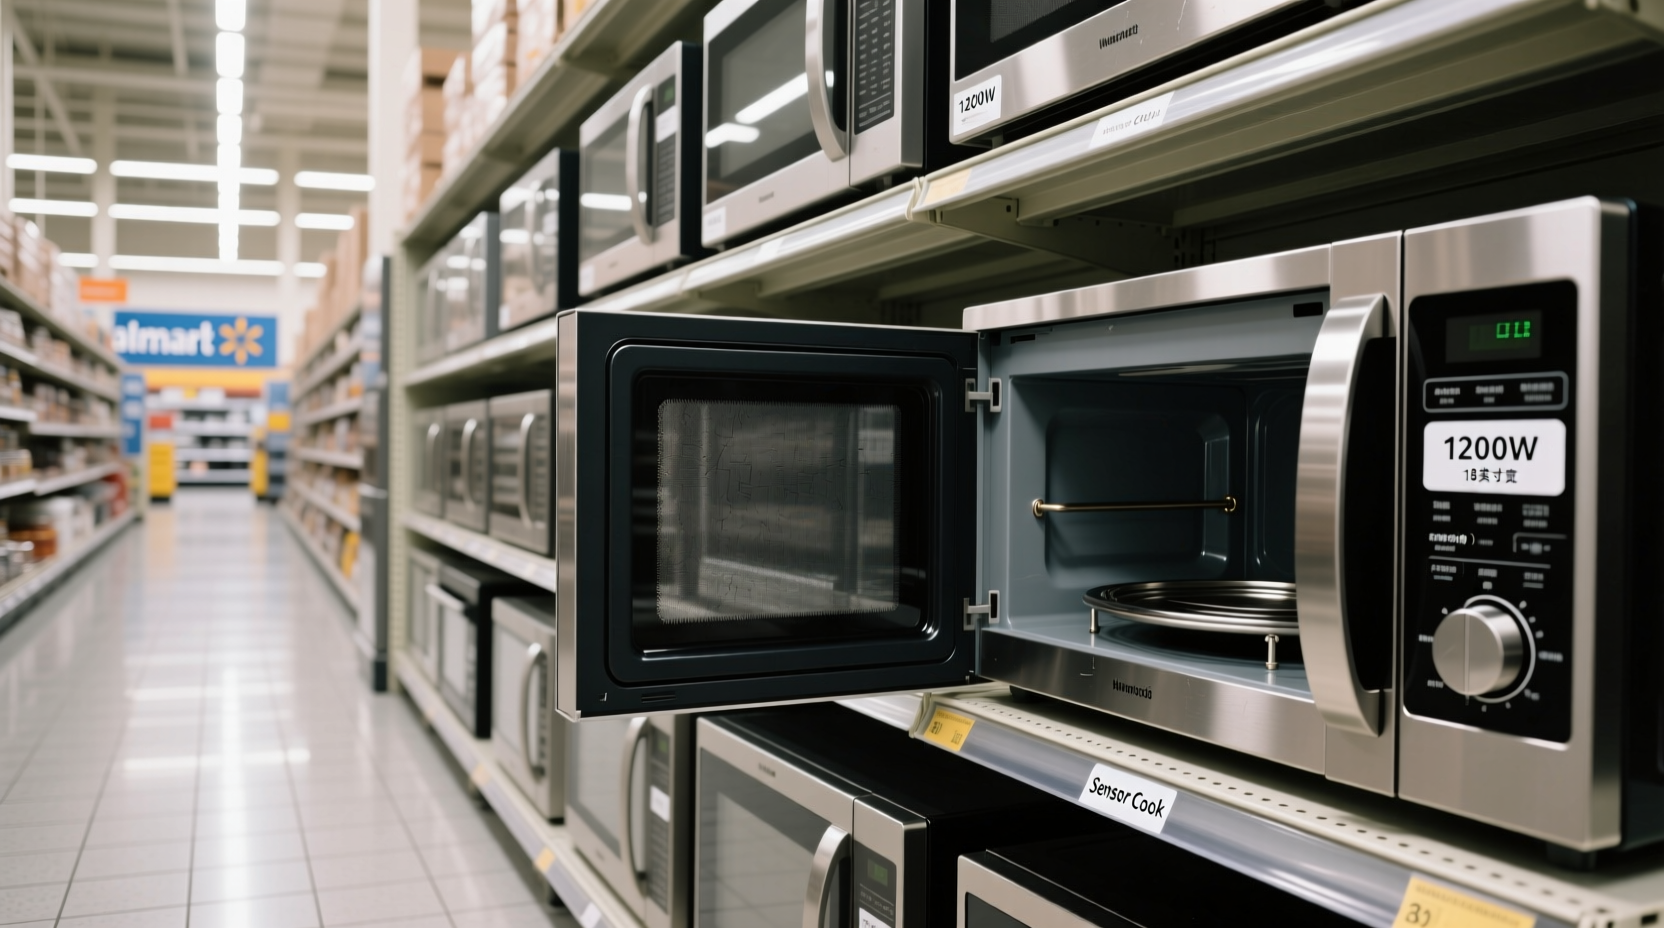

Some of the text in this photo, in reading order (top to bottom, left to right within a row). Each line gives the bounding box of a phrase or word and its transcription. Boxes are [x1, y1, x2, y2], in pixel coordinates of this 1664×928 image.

[959, 86, 996, 113] 1200W
[1444, 436, 1538, 461] 1200W
[1089, 777, 1165, 818] Sensor Cook
